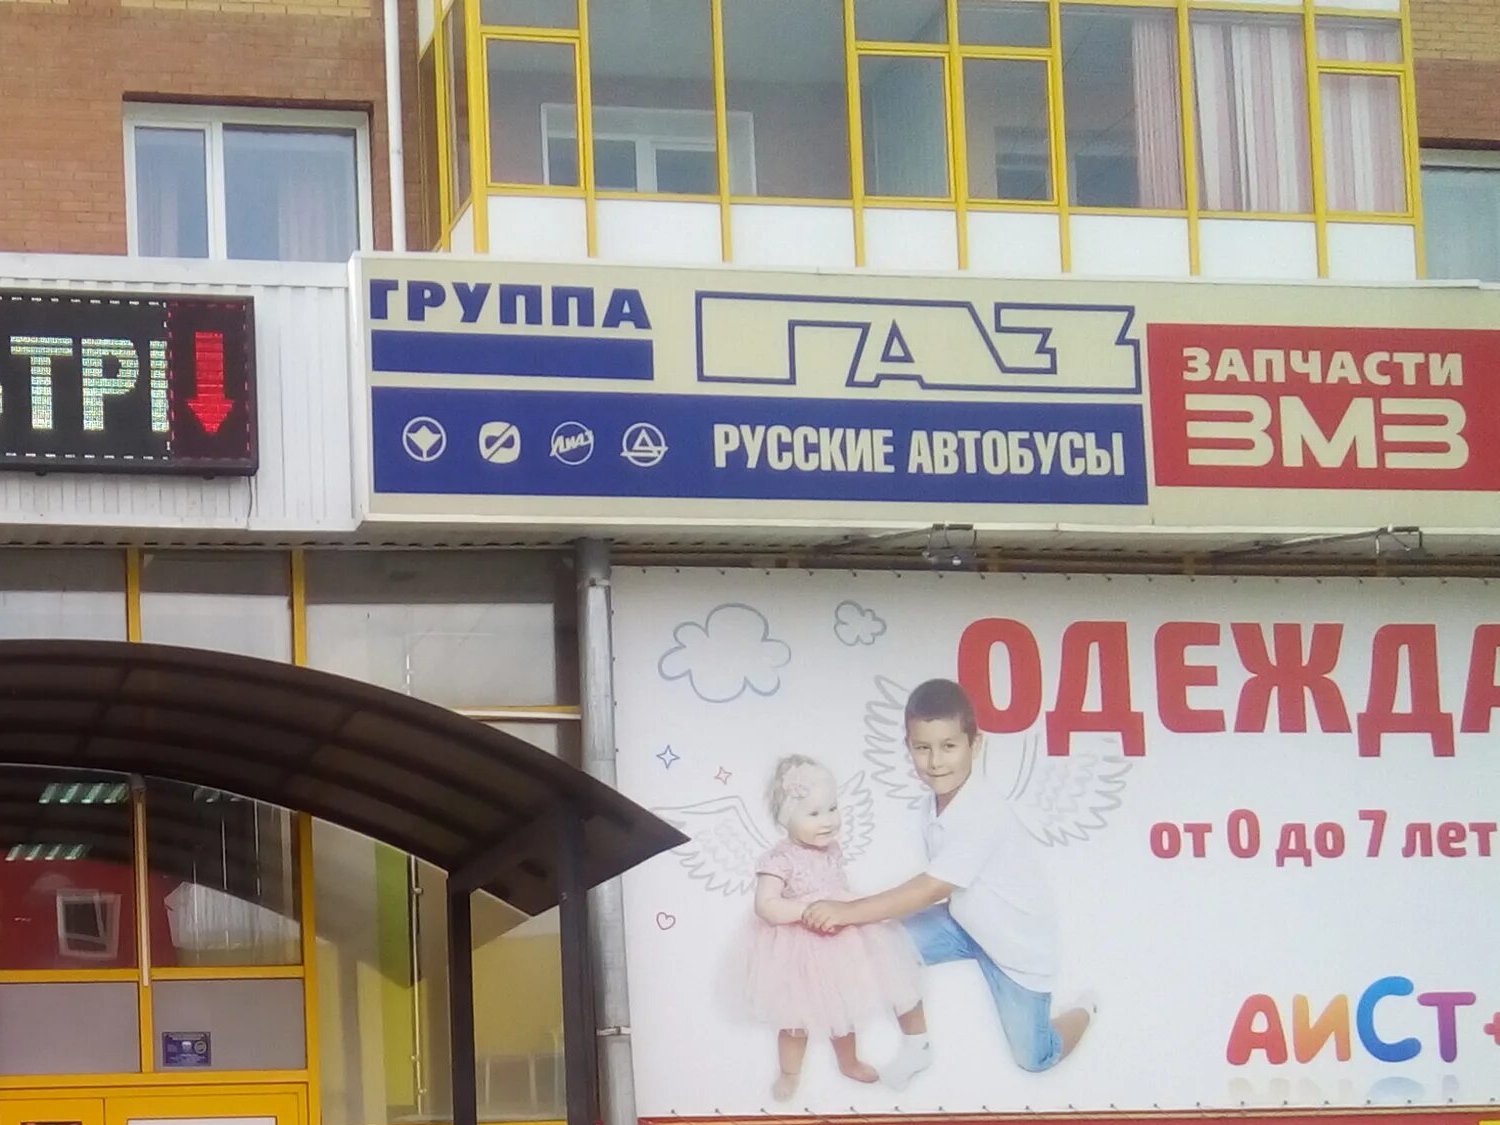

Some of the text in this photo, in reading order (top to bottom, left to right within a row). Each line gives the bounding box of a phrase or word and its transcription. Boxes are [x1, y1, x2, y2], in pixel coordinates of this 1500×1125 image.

[370, 279, 1142, 394] ГРУППА ГАЗ
[1181, 346, 1464, 387] ЗАПЧАСТИ
[713, 423, 1126, 476] РУССКИЕ АВТОБУСЫ
[1184, 393, 1470, 470] ЗМЗ
[1149, 808, 1498, 868] от 0 до 7 лет
